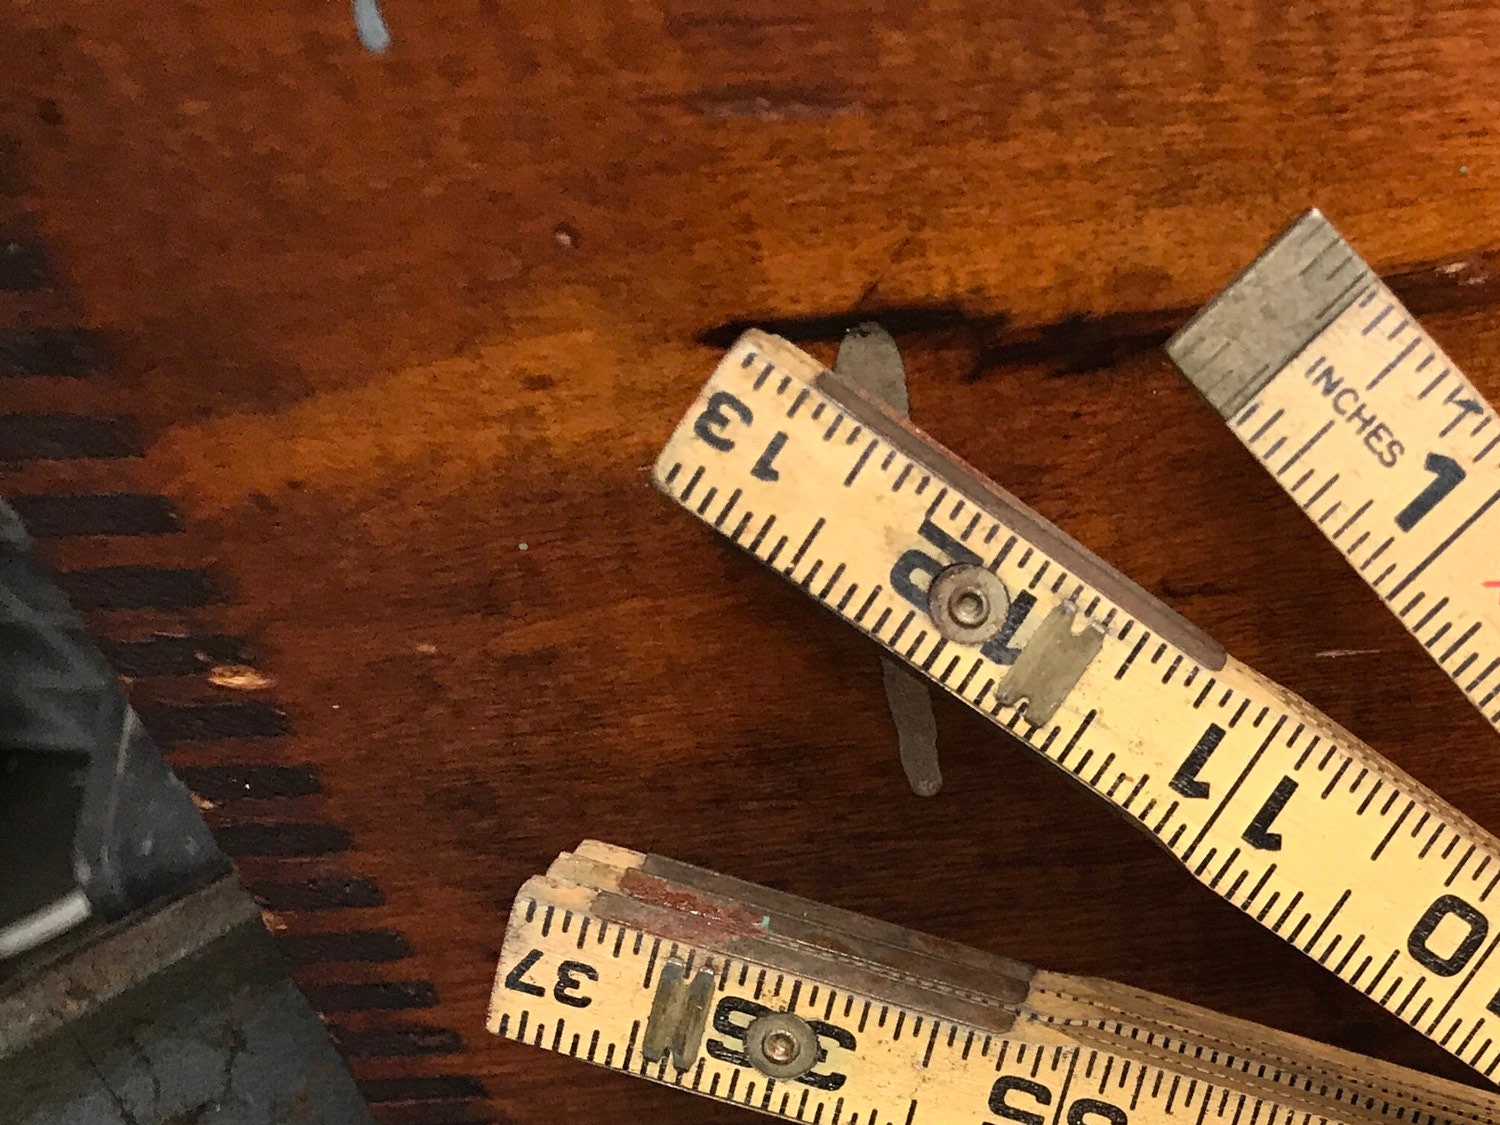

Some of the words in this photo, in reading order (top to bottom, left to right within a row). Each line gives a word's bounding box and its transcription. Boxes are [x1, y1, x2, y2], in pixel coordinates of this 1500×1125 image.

[692, 391, 789, 483] 13
[1305, 357, 1405, 470] INCHES
[1394, 453, 1466, 532] 1
[1168, 722, 1300, 852] 11
[503, 949, 599, 1009] 37
